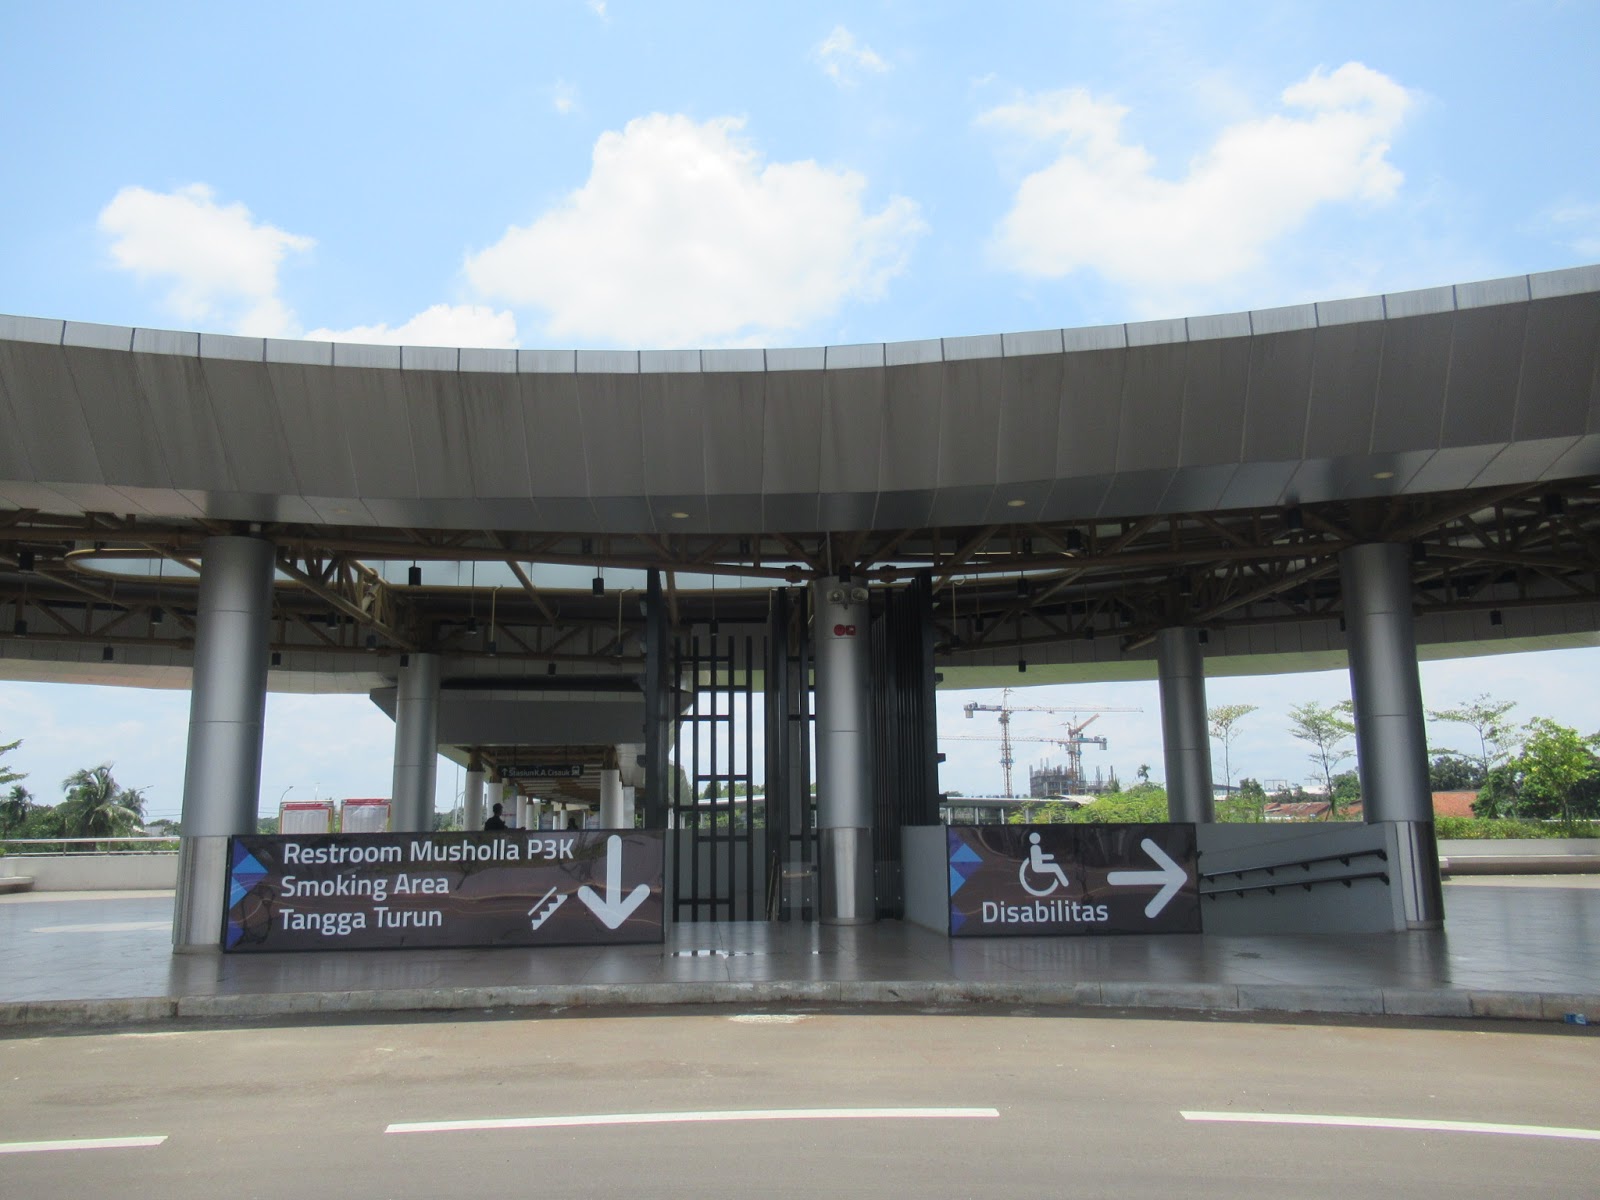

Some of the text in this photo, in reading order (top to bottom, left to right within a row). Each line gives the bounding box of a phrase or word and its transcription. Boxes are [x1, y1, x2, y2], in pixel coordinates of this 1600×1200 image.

[508, 768, 535, 777] Stasiun
[547, 768, 570, 777] Cisauk
[283, 838, 574, 864] Restroom Musholla P3K
[281, 873, 450, 902] Smoking Area
[279, 906, 442, 936] Tangga Turun
[982, 900, 1109, 923] Disabilitas
